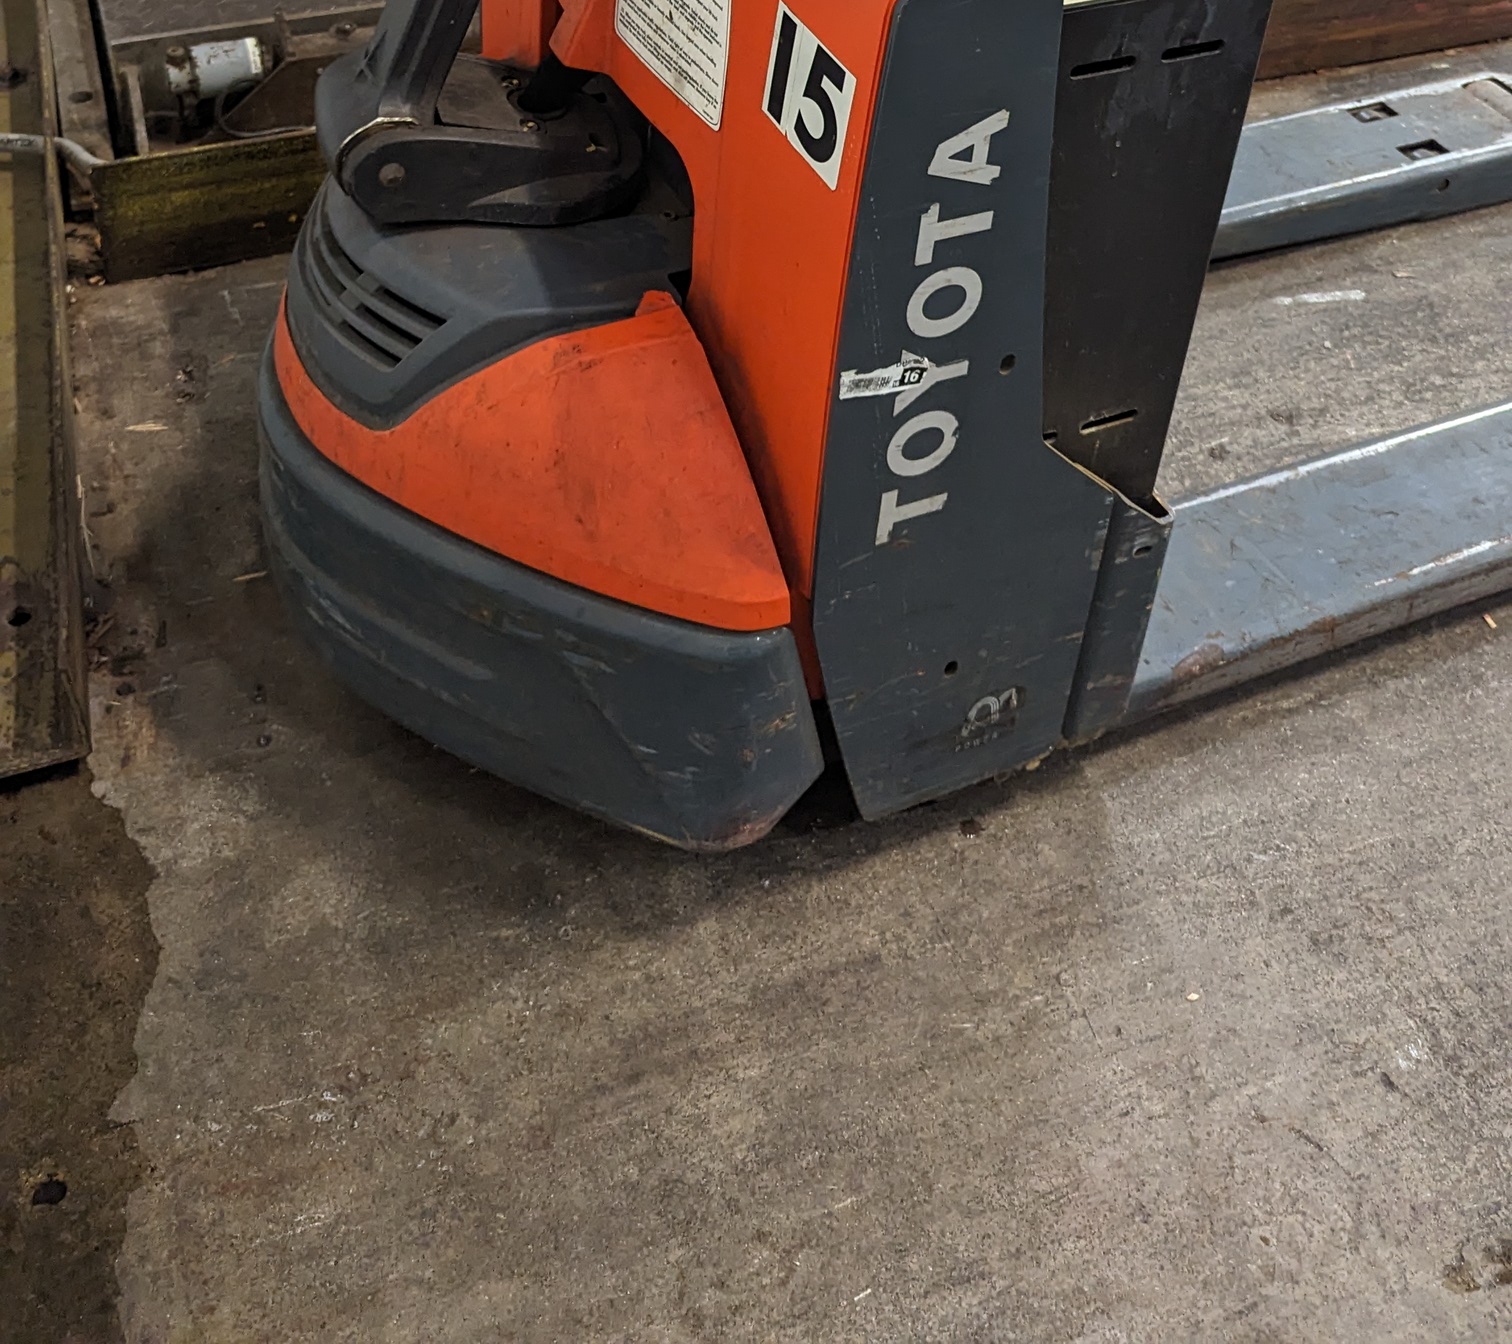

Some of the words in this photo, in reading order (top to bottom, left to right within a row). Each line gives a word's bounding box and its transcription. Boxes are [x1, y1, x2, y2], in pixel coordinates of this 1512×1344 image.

[767, 11, 846, 163] 15
[874, 109, 1010, 546] TOYOTA
[904, 370, 921, 383] 16
